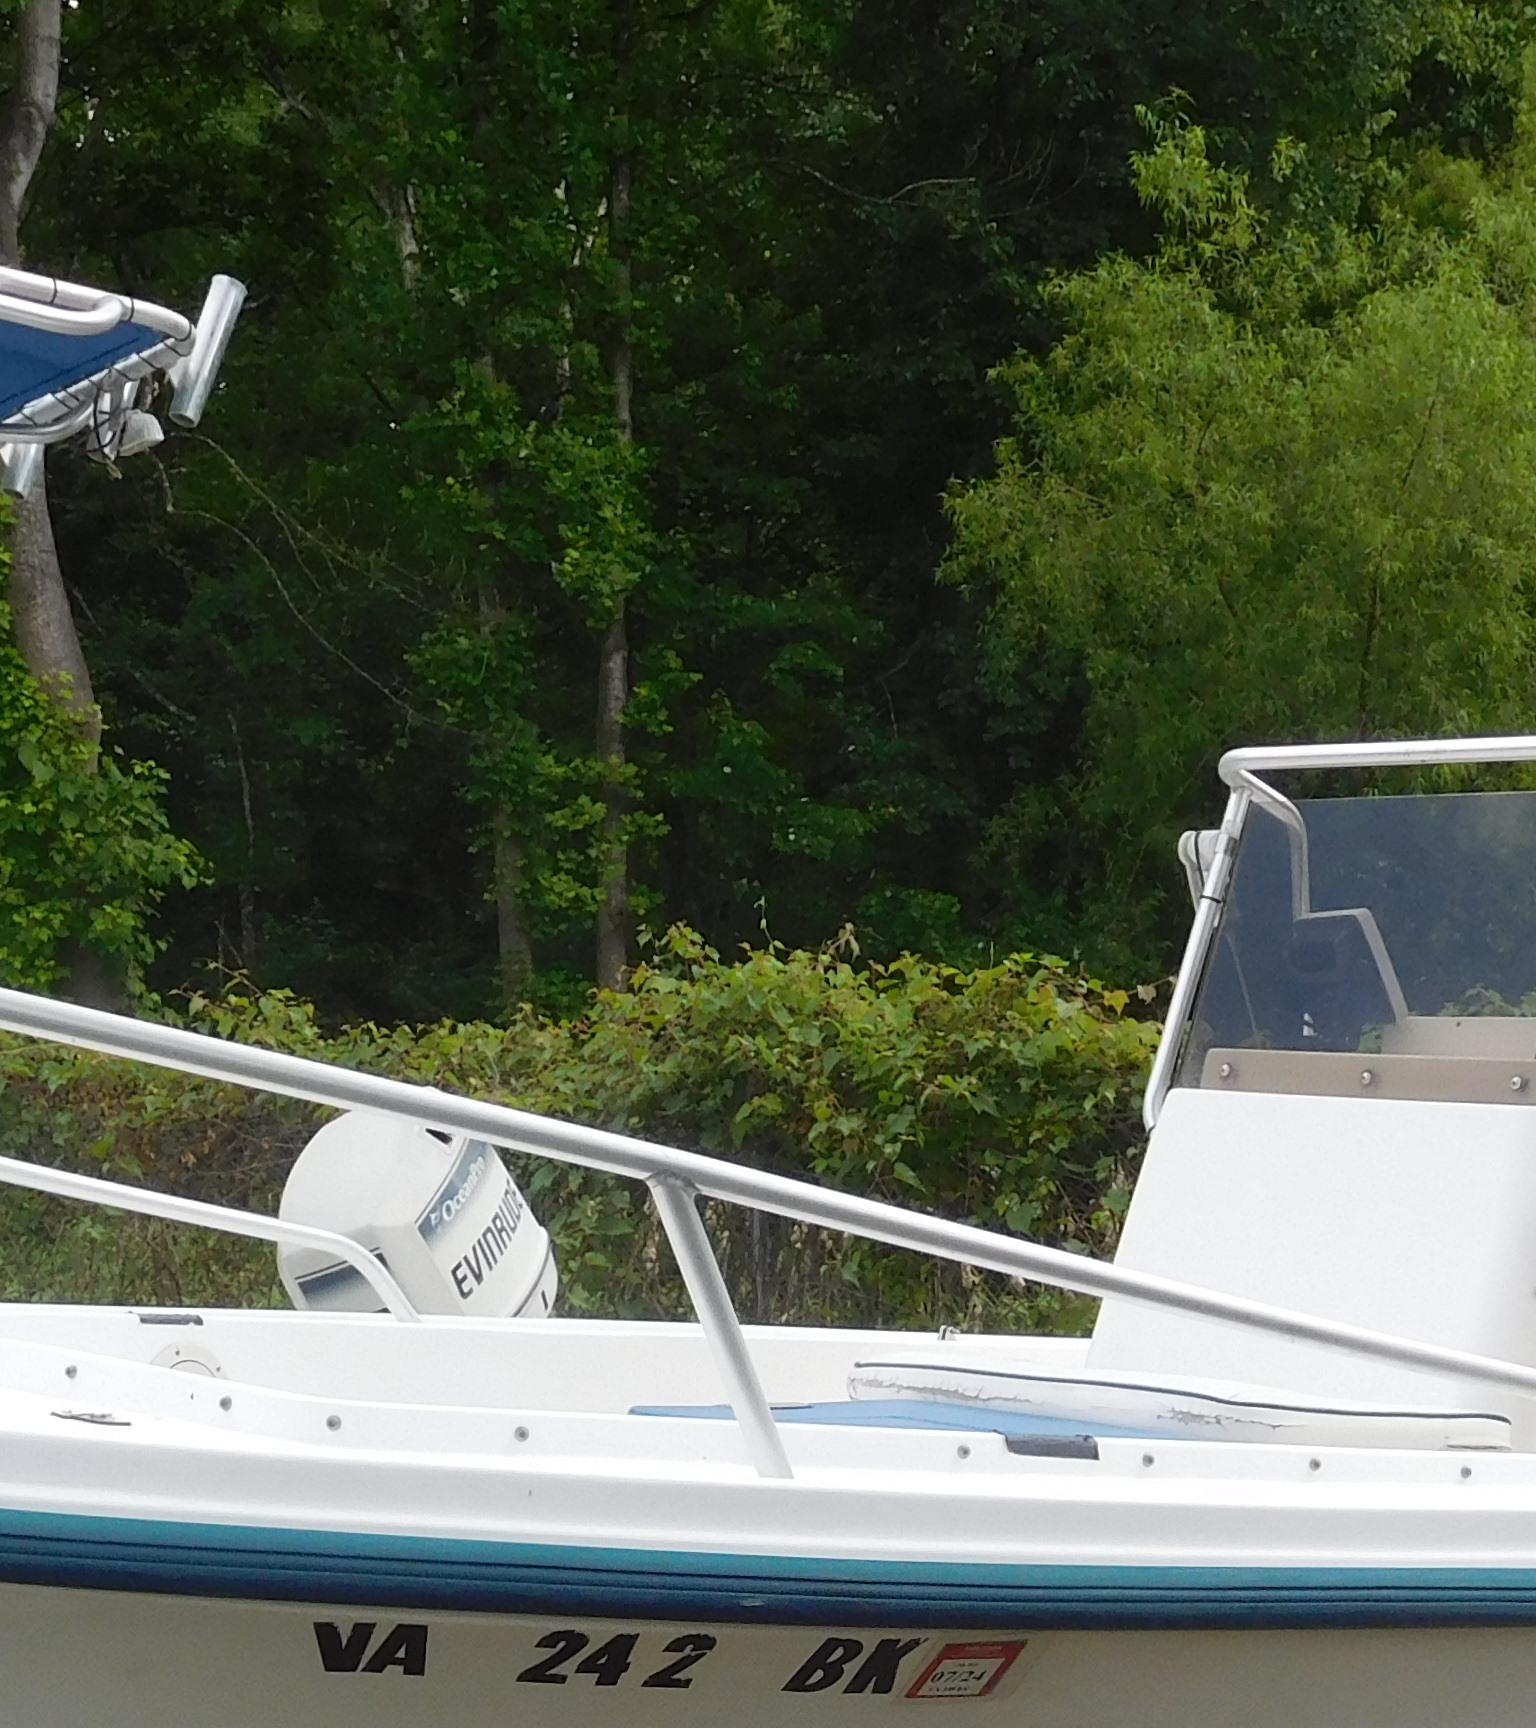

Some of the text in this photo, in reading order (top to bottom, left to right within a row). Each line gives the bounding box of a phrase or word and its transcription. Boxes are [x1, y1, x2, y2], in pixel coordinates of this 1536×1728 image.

[313, 1621, 929, 1695] VA 242 BK
